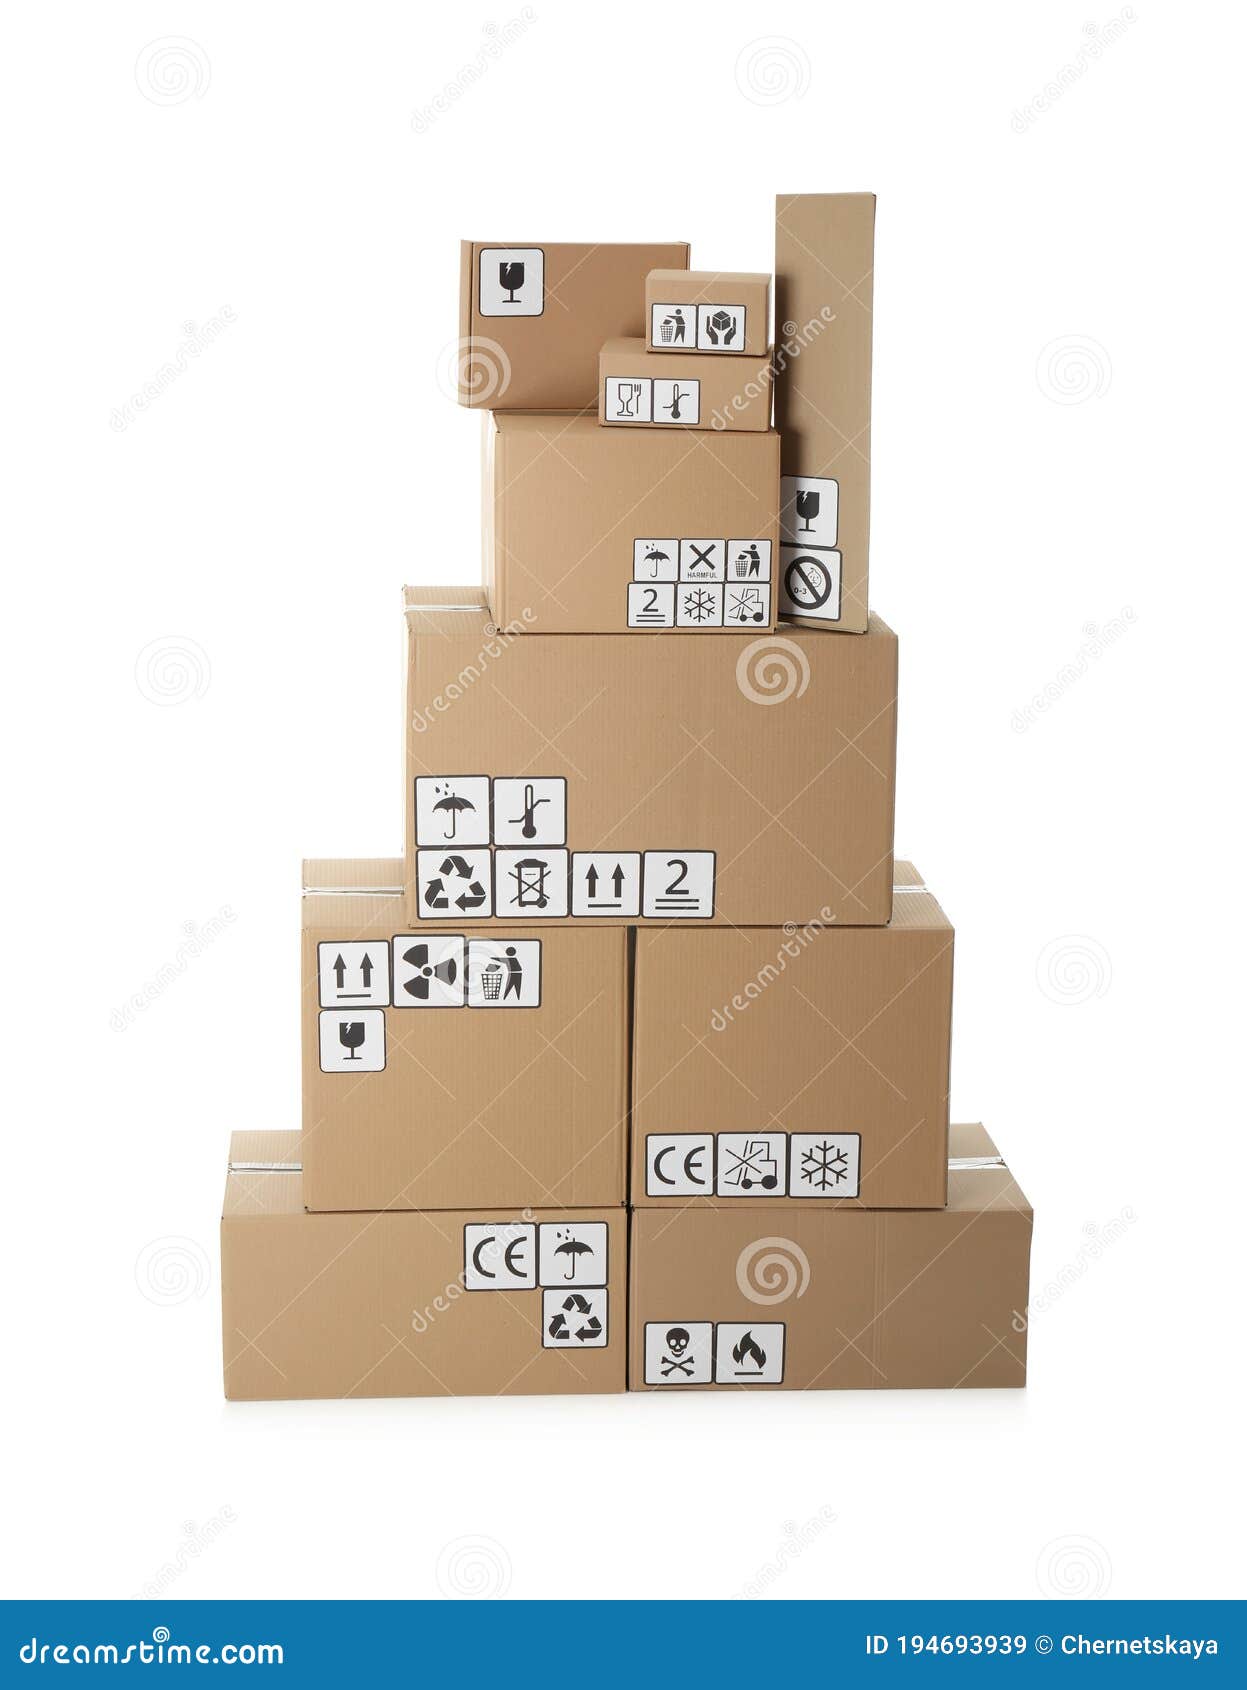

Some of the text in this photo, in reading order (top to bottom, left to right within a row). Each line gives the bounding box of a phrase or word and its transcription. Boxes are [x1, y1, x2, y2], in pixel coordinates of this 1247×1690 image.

[642, 588, 659, 612] 2
[793, 587, 807, 595] 0-3
[665, 859, 689, 895] 2
[653, 1145, 706, 1185] CE
[472, 1236, 528, 1278] CE
